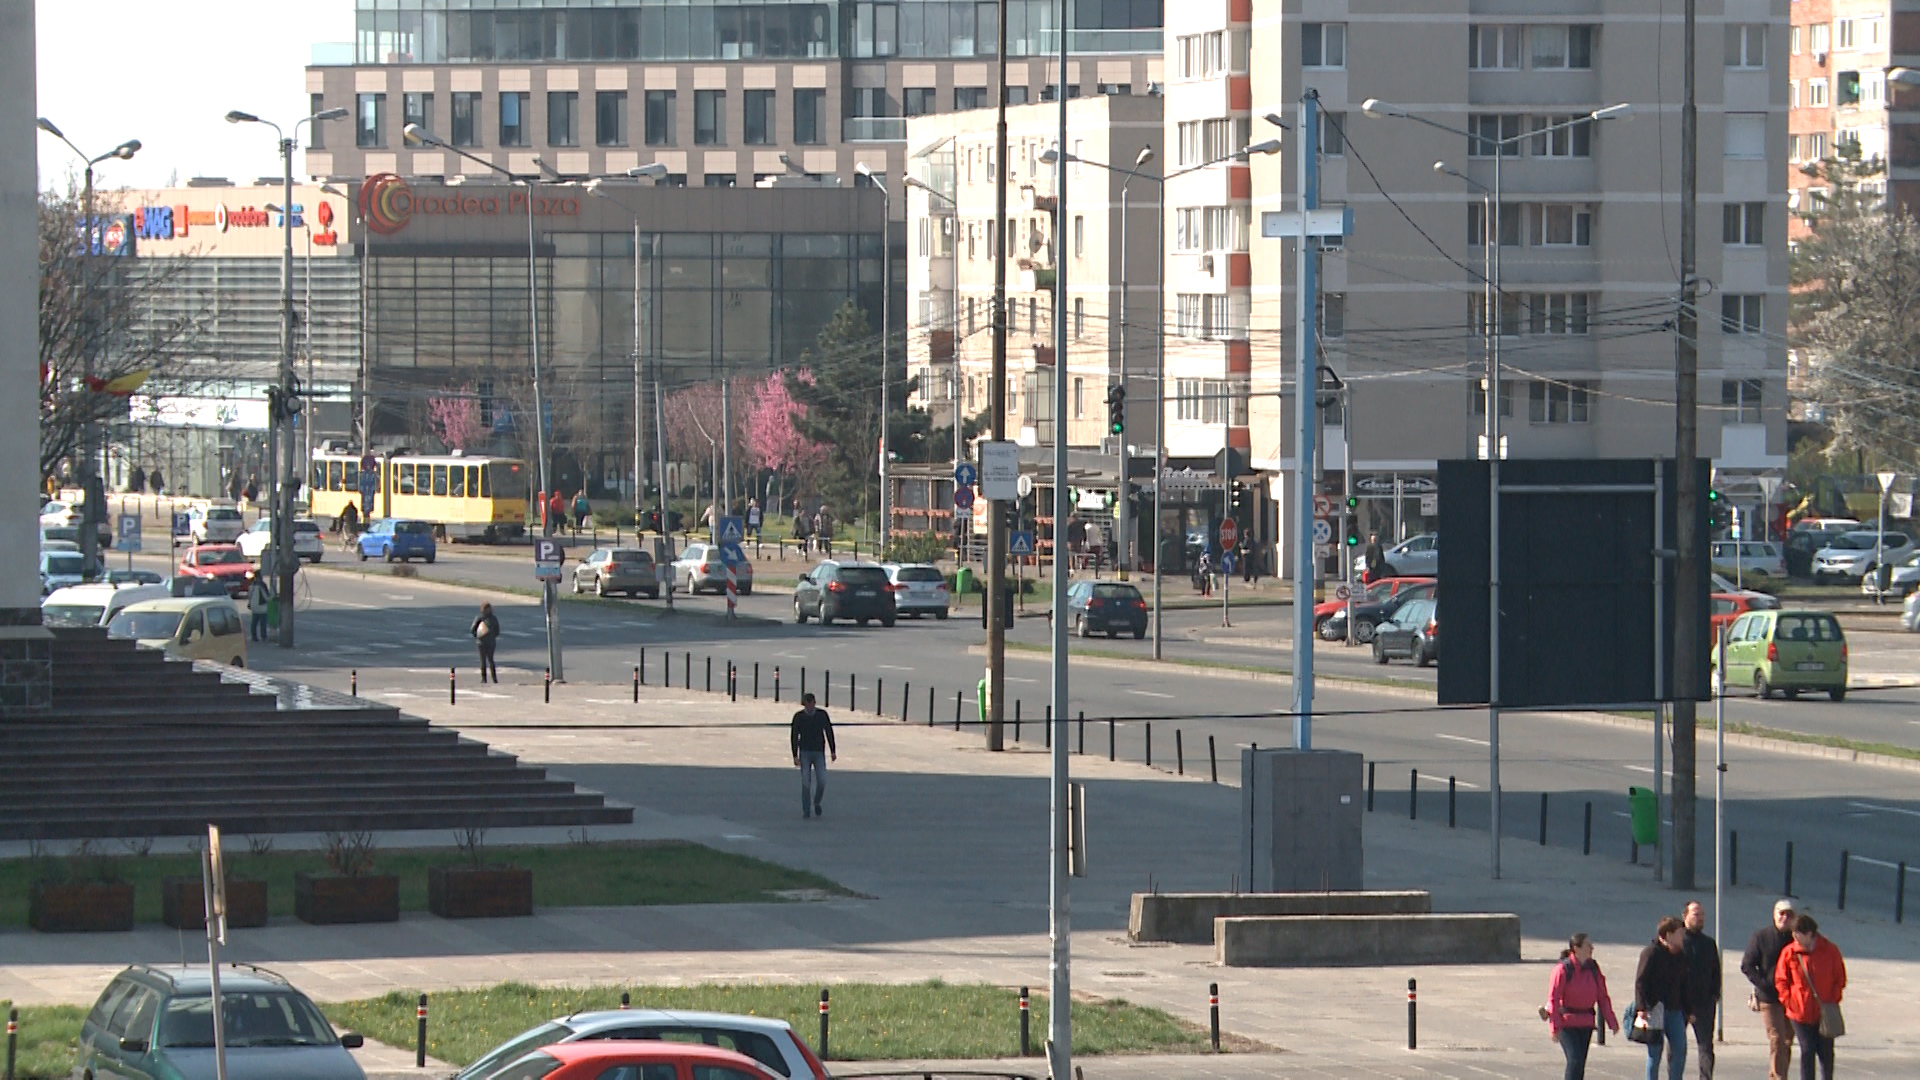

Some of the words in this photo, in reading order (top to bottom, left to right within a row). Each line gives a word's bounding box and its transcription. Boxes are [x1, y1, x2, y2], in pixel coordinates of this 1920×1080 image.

[390, 190, 499, 217] Oradea
[122, 516, 136, 535] P
[1220, 528, 1237, 541] STOP
[540, 541, 555, 560] P
